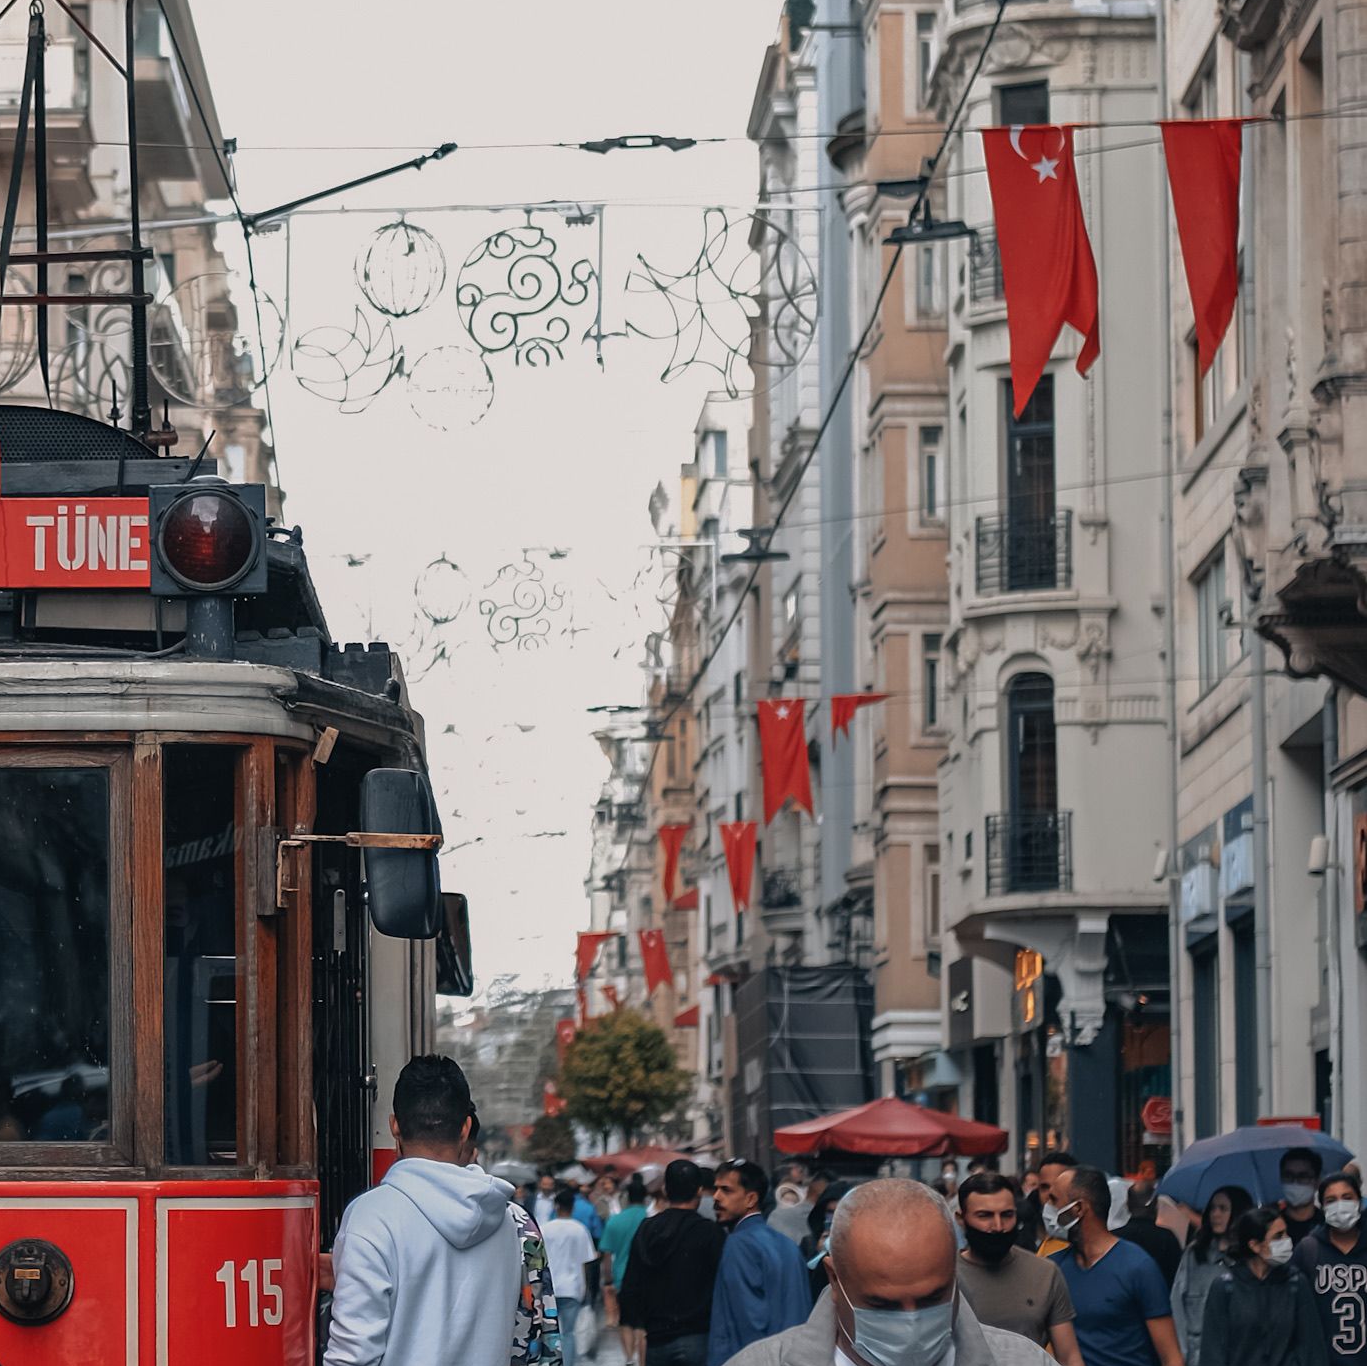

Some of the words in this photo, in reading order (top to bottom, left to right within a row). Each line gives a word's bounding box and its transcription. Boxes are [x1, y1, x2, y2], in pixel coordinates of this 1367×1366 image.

[216, 1258, 284, 1328] 115
[1315, 1263, 1367, 1294] USP
[1331, 1292, 1367, 1355] 3
